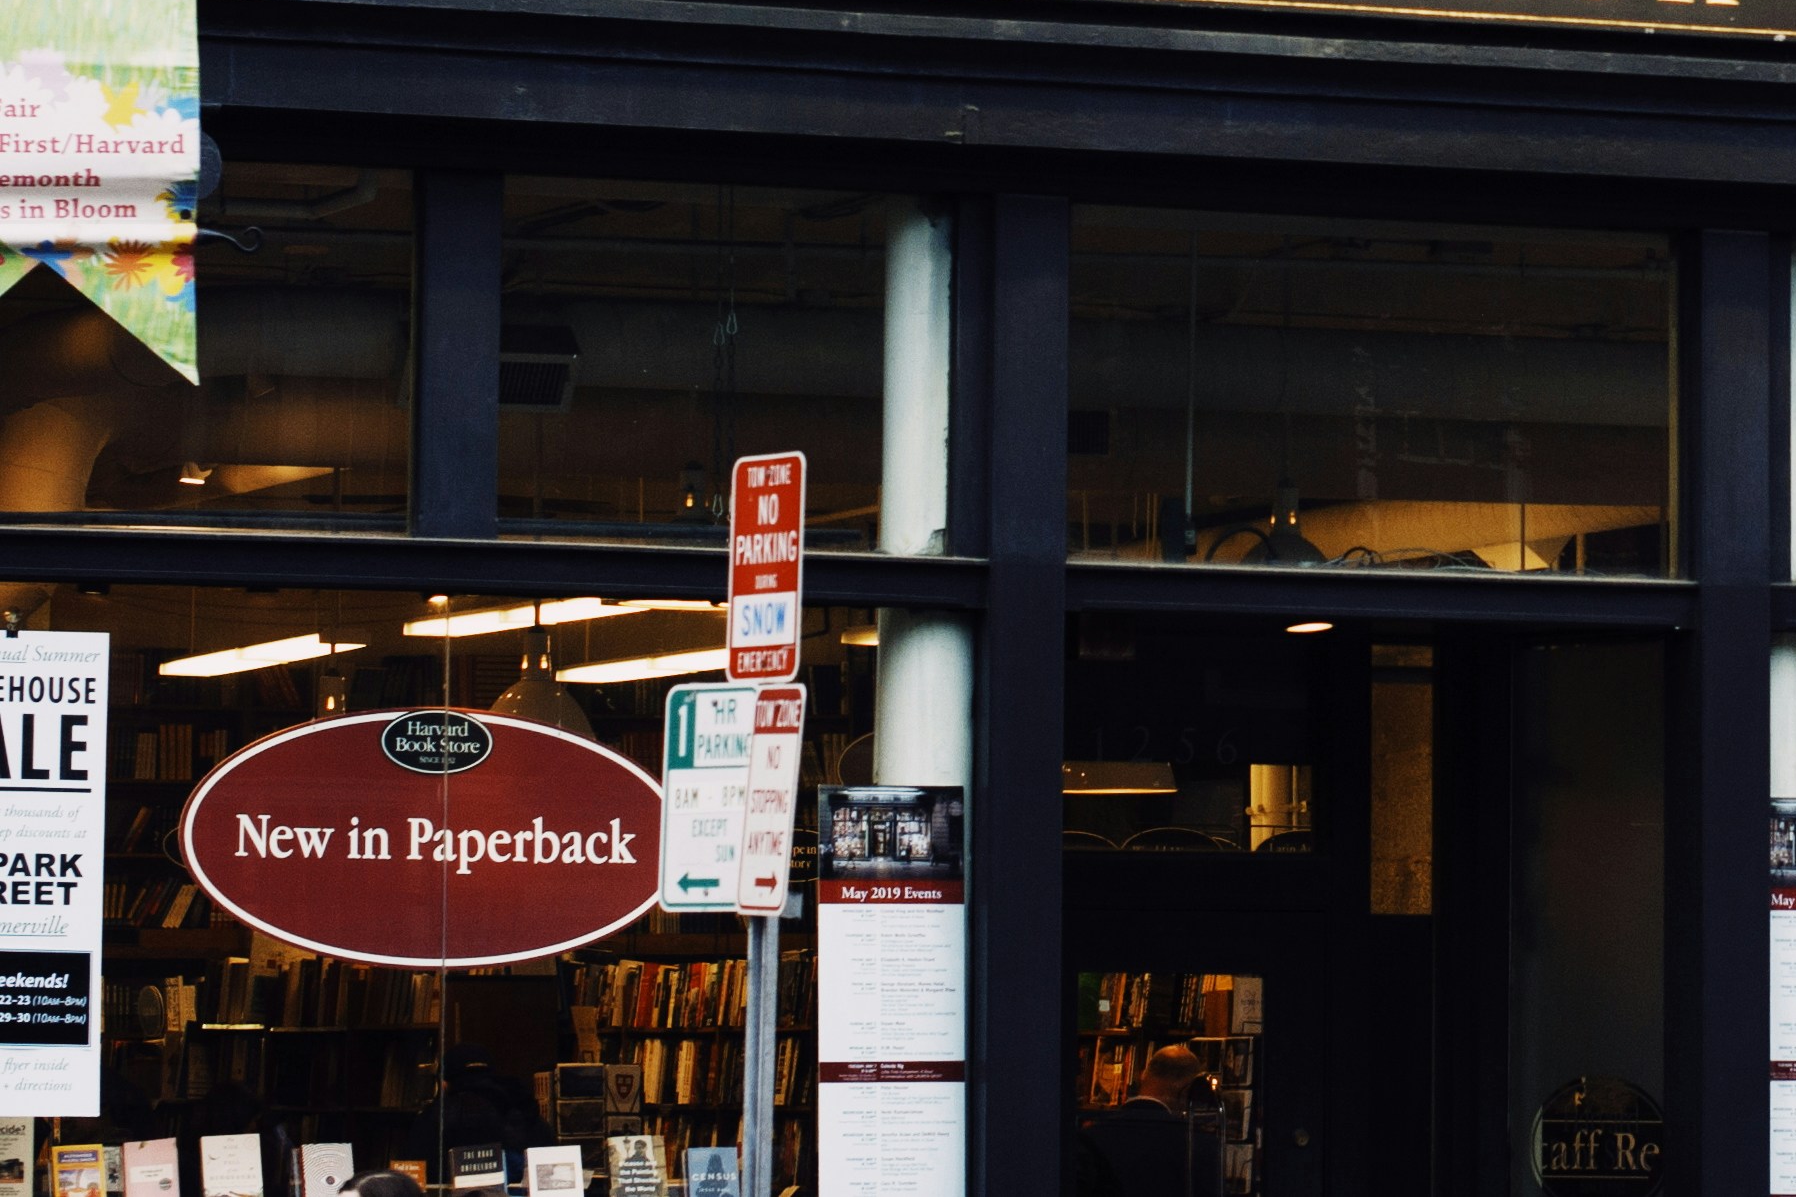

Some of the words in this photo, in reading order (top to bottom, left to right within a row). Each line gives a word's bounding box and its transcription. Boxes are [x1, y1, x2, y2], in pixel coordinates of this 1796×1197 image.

[0, 98, 41, 118] air
[20, 199, 45, 219] in
[54, 197, 137, 219] Bloom
[757, 493, 779, 526] NO
[735, 530, 797, 566] PARKING
[741, 602, 787, 637] SNOW
[32, 645, 100, 663] Summer
[737, 650, 788, 673] EMERGENCY
[714, 699, 737, 724] HR
[395, 737, 436, 753] Book
[440, 737, 481, 754] Store
[766, 745, 780, 769] NO
[4, 804, 65, 818] thousands
[750, 789, 789, 814] STOPPING
[16, 824, 71, 839] discounts
[74, 829, 87, 839] at
[691, 818, 728, 838] EXCEPT
[234, 813, 335, 859] New
[347, 816, 391, 860] in
[406, 816, 637, 875] Paperback
[715, 845, 735, 863] SUN
[747, 831, 785, 857] ANYTIME
[841, 886, 868, 902] May
[871, 886, 901, 899] 2019
[904, 886, 942, 900] Events
[1771, 894, 1796, 909] May
[14, 1077, 72, 1091] directions
[691, 1172, 737, 1181] CENSUS
